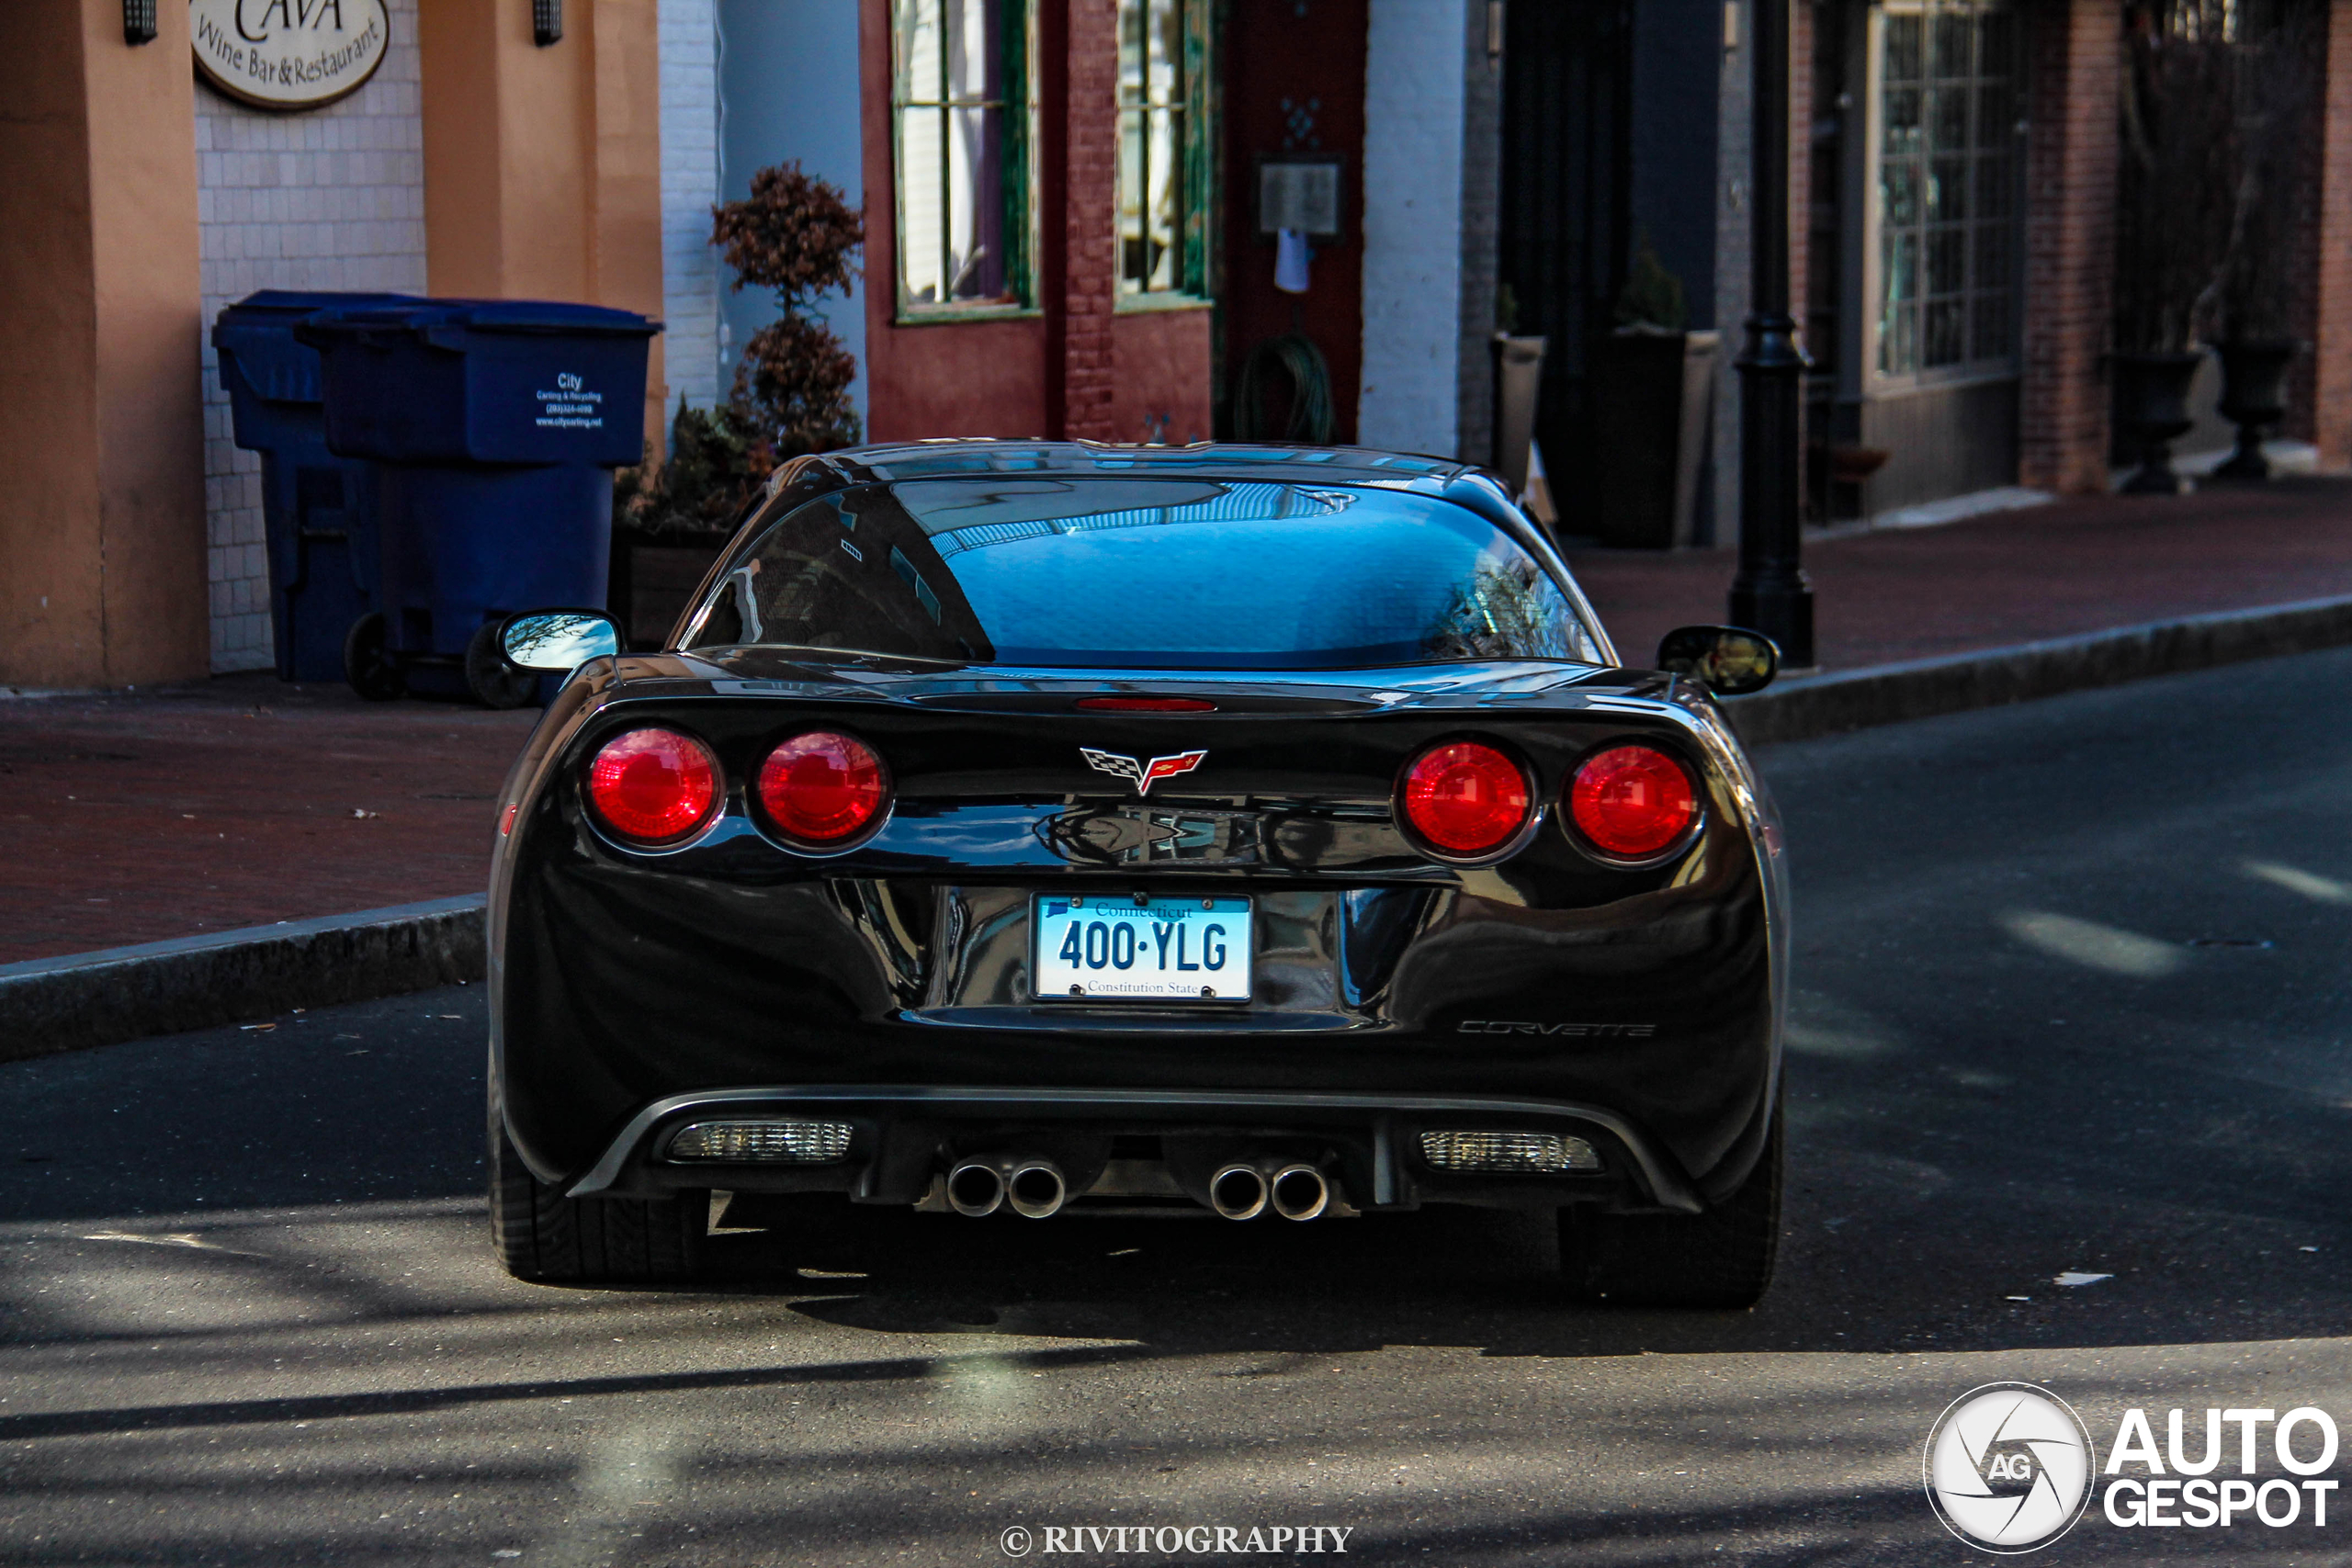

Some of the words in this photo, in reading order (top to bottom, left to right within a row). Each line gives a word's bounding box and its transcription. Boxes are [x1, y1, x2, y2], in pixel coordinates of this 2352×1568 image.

[198, 13, 243, 71] Wine
[294, 17, 379, 85] Restaurant
[558, 372, 582, 392] City
[537, 390, 561, 401] Carting
[570, 391, 601, 404] Recycling
[1095, 902, 1193, 919] Connecticut
[1088, 980, 1163, 993] Constitution
[1168, 982, 1198, 994] State
[1457, 1021, 1656, 1036] CORVETTE
